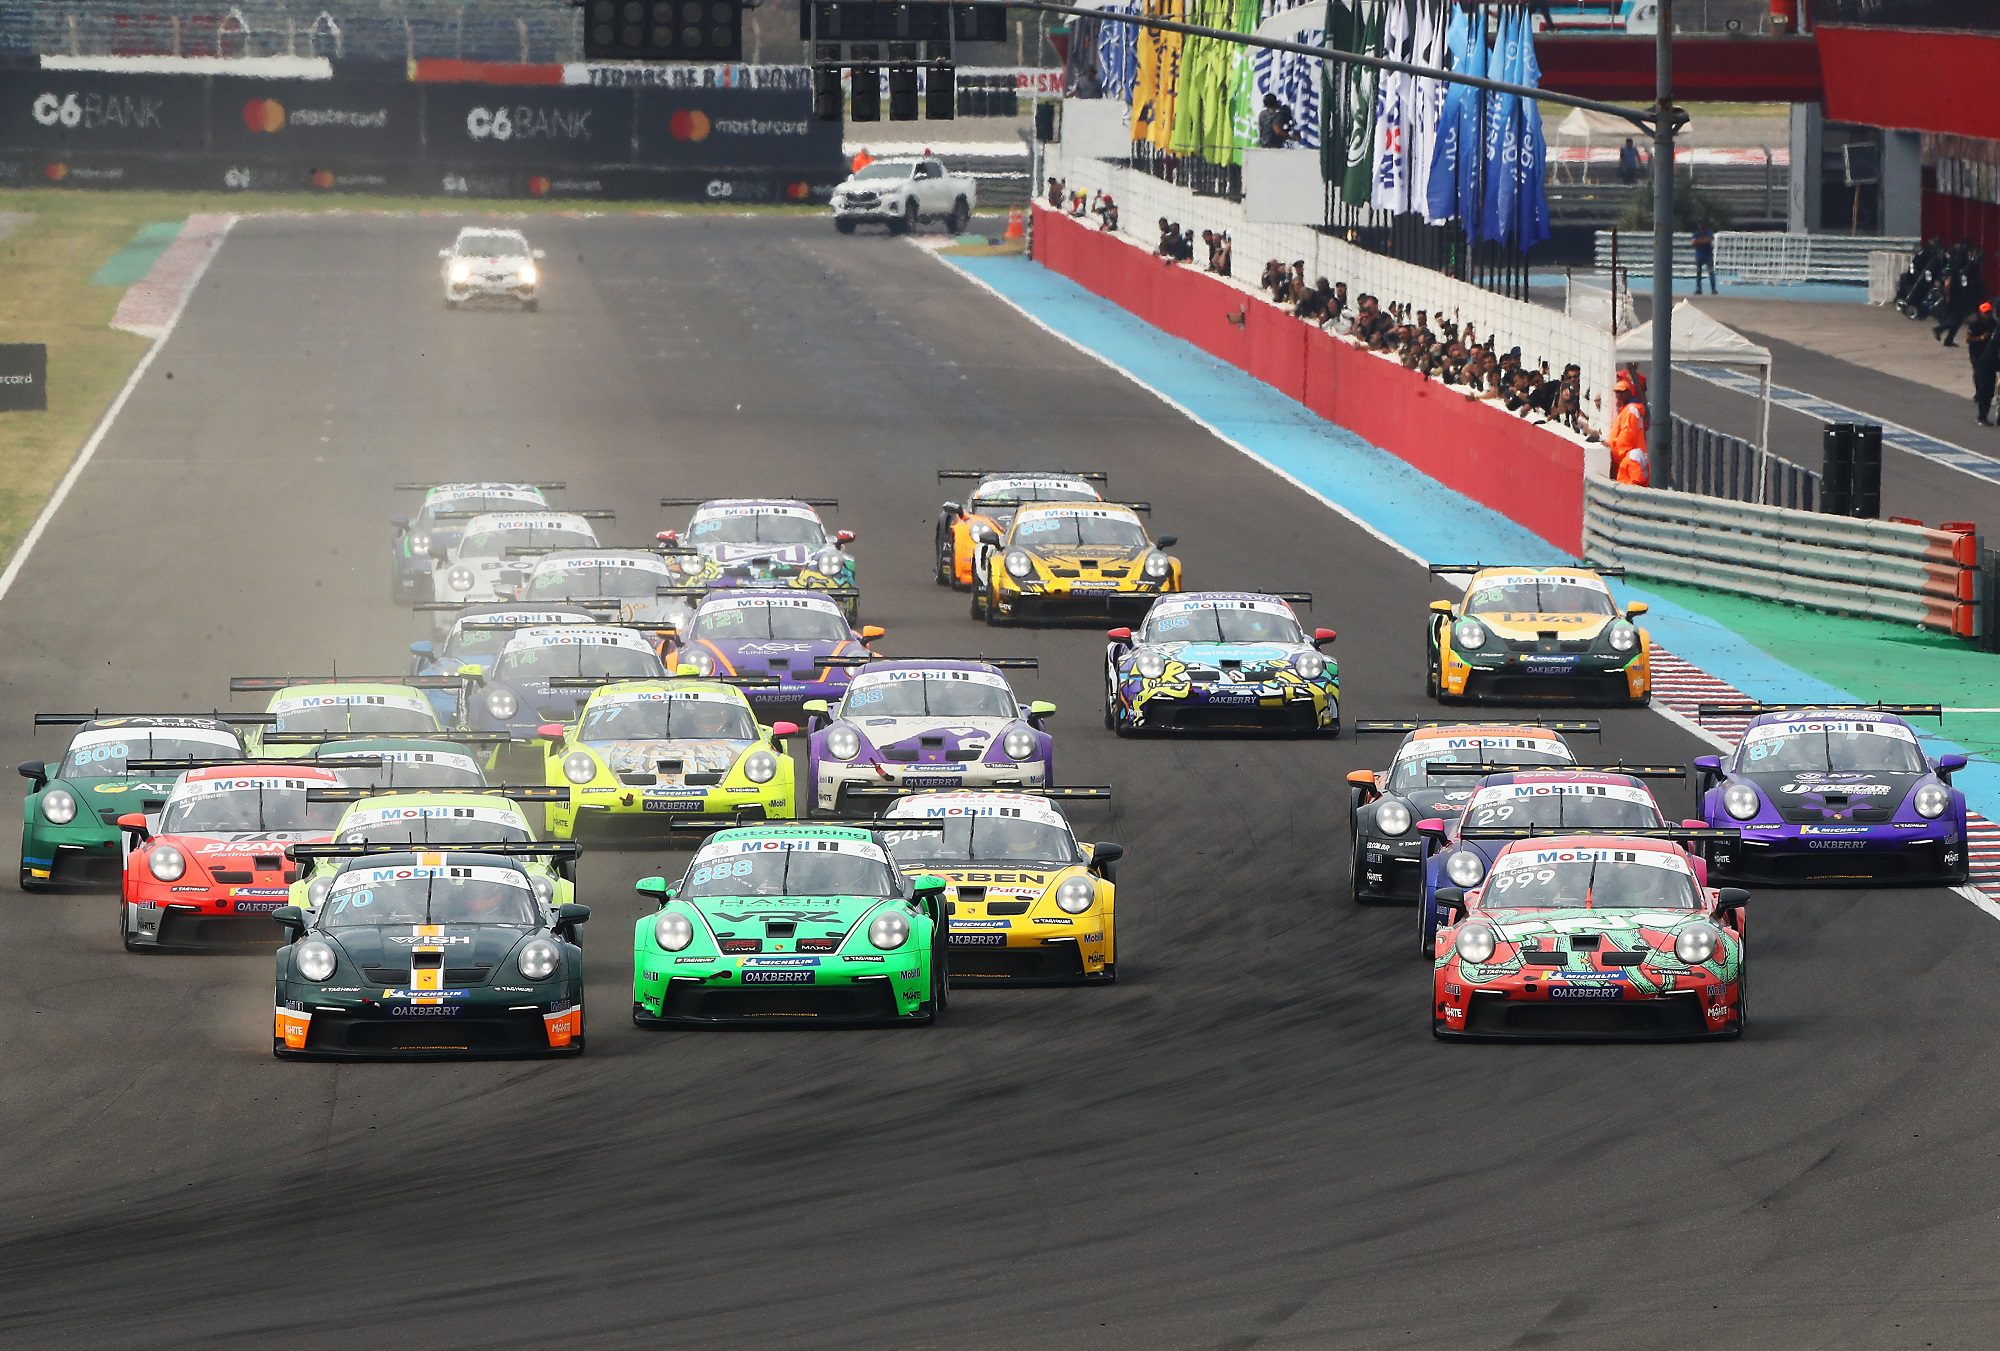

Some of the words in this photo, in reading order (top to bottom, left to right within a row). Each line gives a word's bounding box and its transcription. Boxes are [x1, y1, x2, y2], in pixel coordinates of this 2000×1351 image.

[1014, 73, 1064, 92] RISM
[715, 118, 809, 136] mastercard
[1183, 602, 1234, 610] Mobil
[543, 636, 596, 646] Mobil
[889, 671, 946, 680] Mobil
[302, 695, 362, 707] Mobil
[755, 694, 804, 703] OAKBERRY
[850, 689, 883, 708] 88
[1208, 696, 1257, 704] OAKBERRY
[590, 707, 623, 727] 77
[1788, 724, 1849, 734] Mobil
[1448, 739, 1510, 748] Mobil
[74, 743, 129, 766] 800
[1750, 739, 1786, 761] 87
[214, 779, 279, 791] Mobil
[905, 778, 960, 787] OAKBERRY
[1514, 785, 1580, 796] Mobil
[179, 801, 196, 819] 7
[645, 801, 701, 811] OAKBERRY
[926, 806, 993, 818] Mobil
[381, 807, 448, 820] Mobil
[1478, 805, 1514, 826] 29
[718, 828, 868, 840] AutoBanking
[741, 840, 810, 853] Mobil
[1808, 840, 1868, 850] OAKBERRY
[1537, 851, 1607, 863] Mobil
[373, 867, 444, 881] Mobil
[692, 859, 753, 886] 888
[1495, 869, 1556, 894] 999
[988, 886, 1041, 895] Patrus
[331, 889, 374, 915] 70
[388, 935, 470, 944] WISH
[948, 935, 1003, 945] AKBERRY
[745, 971, 812, 983] OAKBERRY
[1565, 972, 1620, 980] MICHELIN
[1552, 988, 1619, 998] OAKBERRY
[392, 1006, 460, 1017] OAKBERRY
